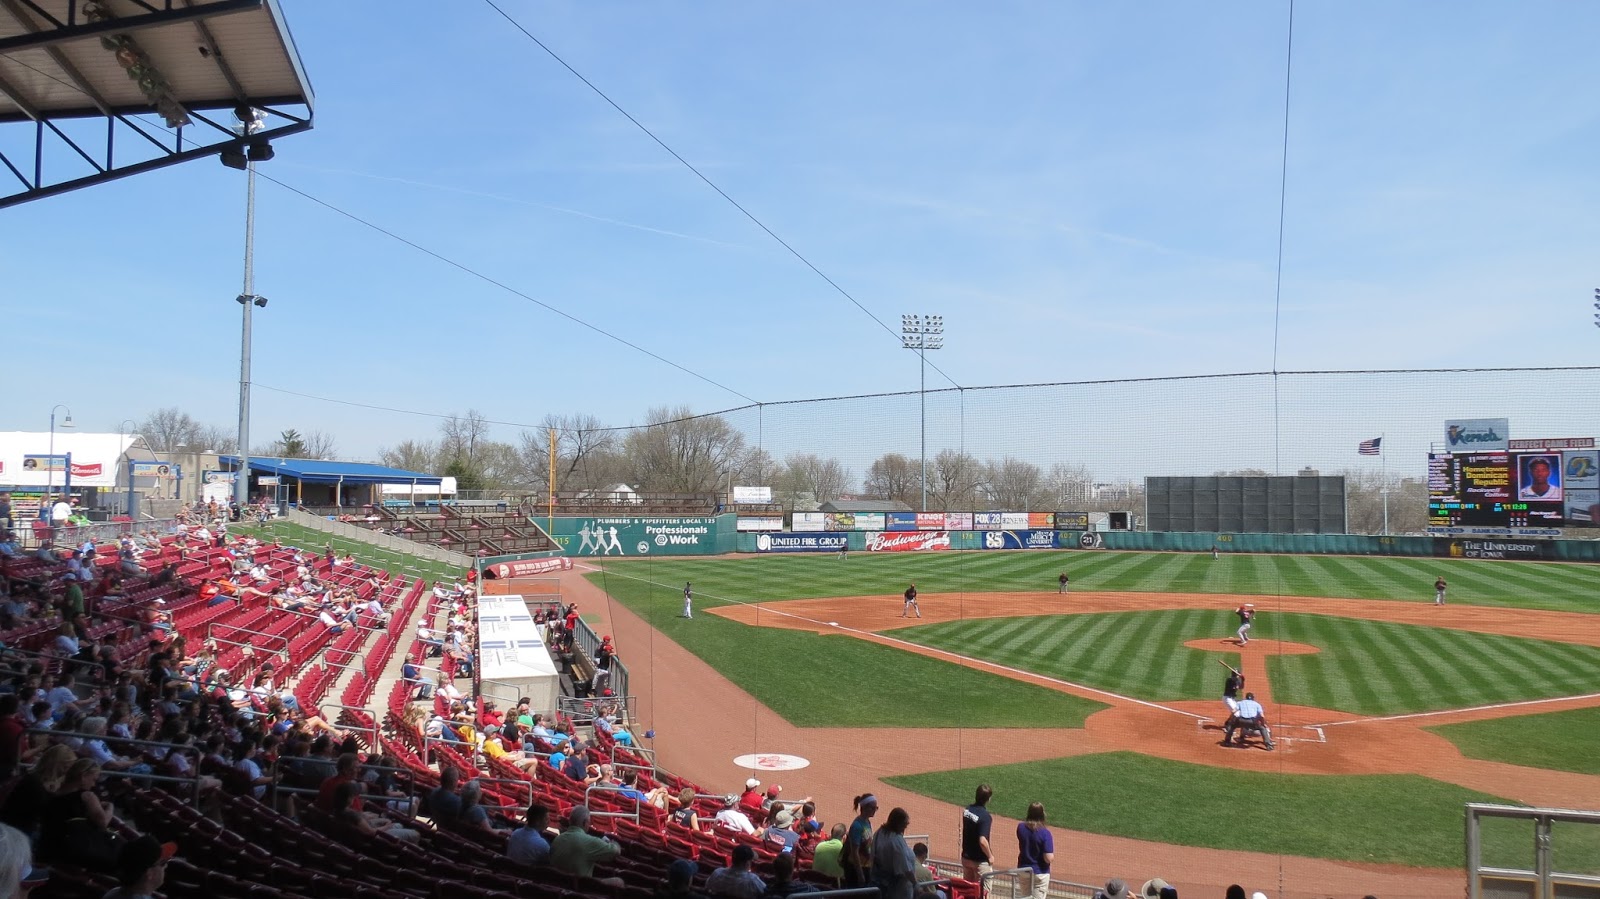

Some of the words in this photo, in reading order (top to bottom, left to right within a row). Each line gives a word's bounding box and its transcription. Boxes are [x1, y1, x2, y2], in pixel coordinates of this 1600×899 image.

[1510, 440, 1543, 448] PERFECT
[1545, 440, 1568, 448] GAME
[1570, 439, 1592, 447] FIELD
[975, 514, 989, 524] FOX
[992, 514, 1000, 523] 28
[646, 525, 708, 534] Professionals
[670, 535, 698, 544] Work
[871, 532, 937, 551] Budweiser
[1463, 541, 1481, 550] THE
[1484, 542, 1536, 551] UNIVERSITY
